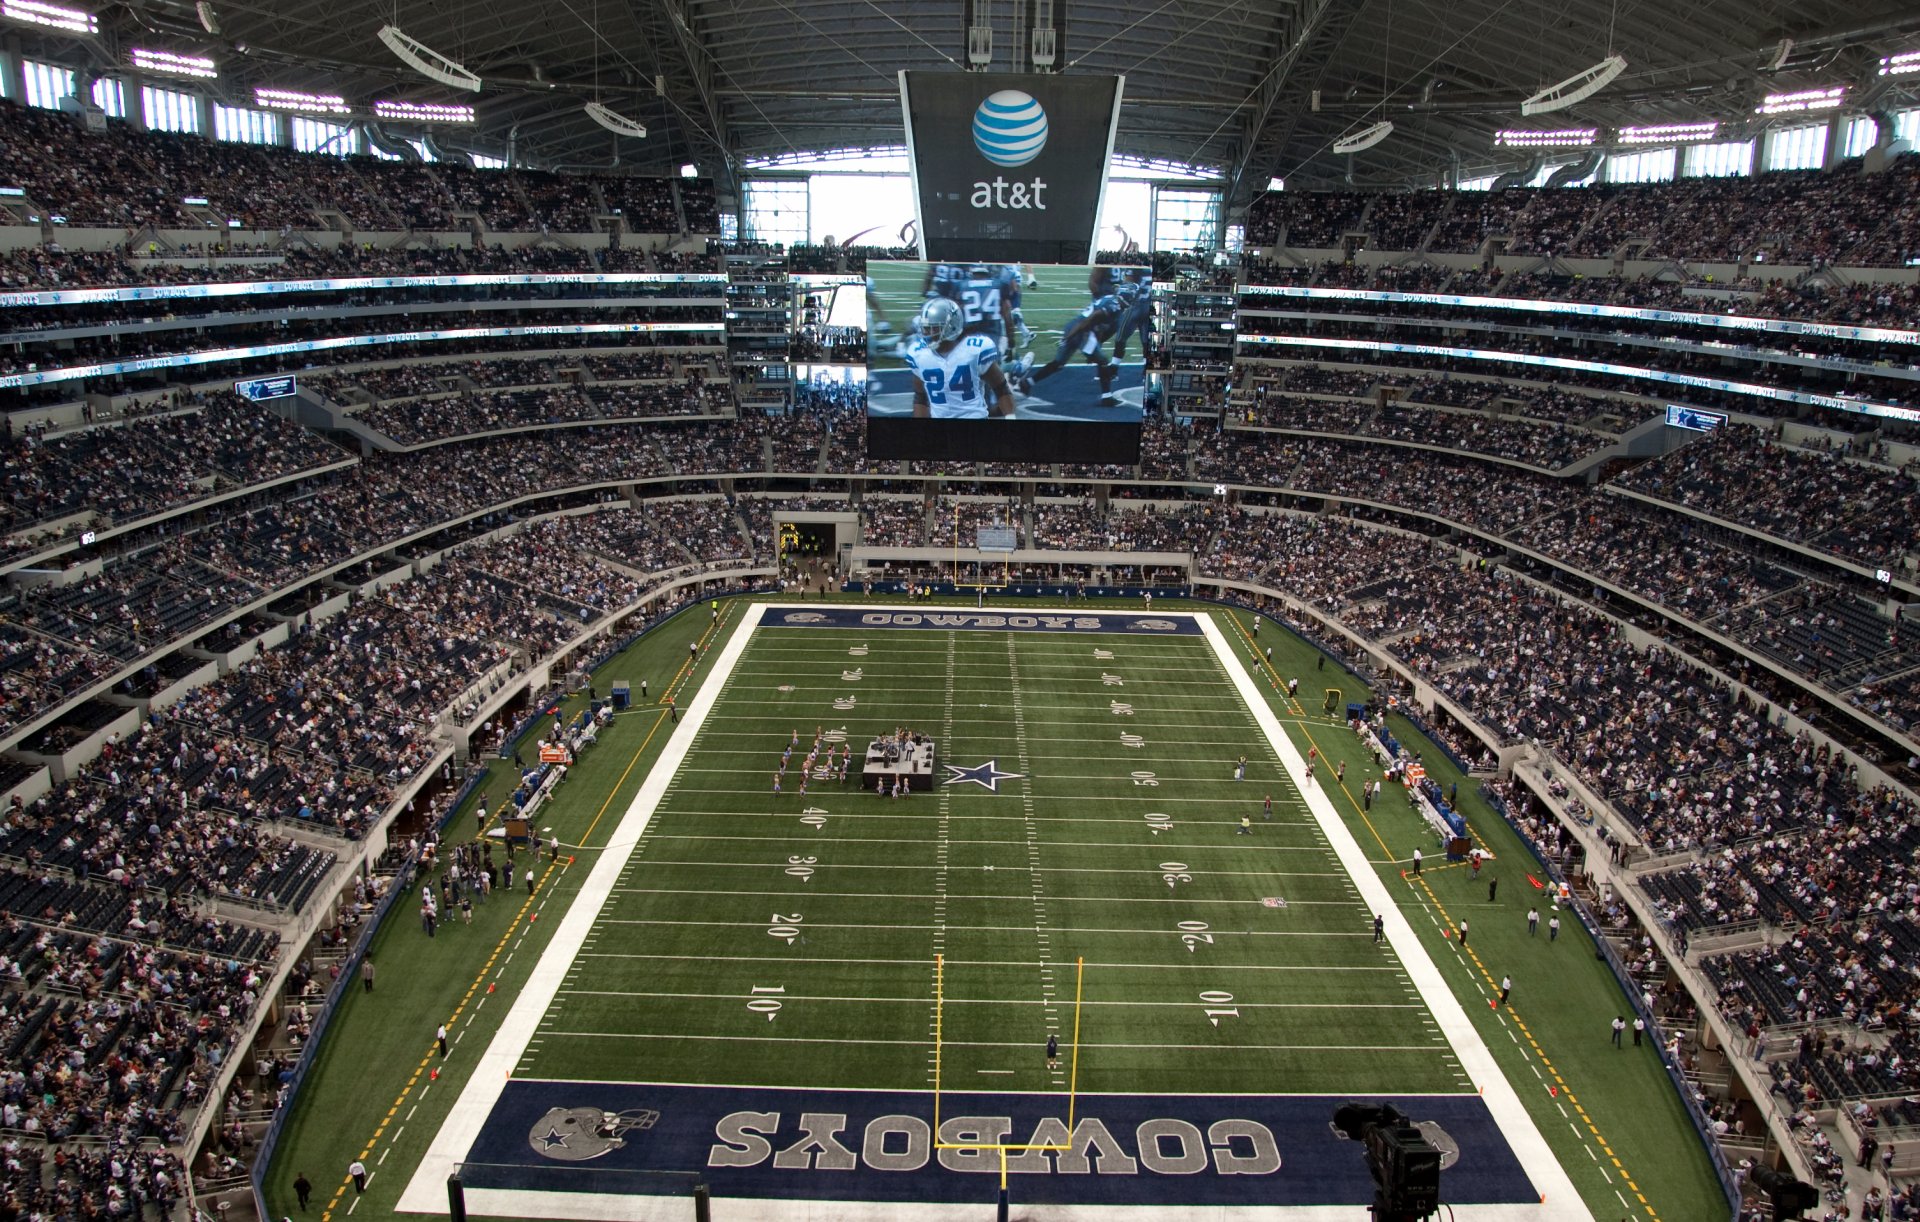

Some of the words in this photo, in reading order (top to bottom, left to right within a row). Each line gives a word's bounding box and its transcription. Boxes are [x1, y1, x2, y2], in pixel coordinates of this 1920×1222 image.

[970, 176, 1047, 210] at&t
[152, 288, 190, 299] COWBOYS
[284, 282, 314, 290] COWBOYS
[404, 277, 438, 285] COWBOYS
[545, 275, 584, 283] COWBOYS
[962, 288, 1001, 323] 24
[1249, 287, 1288, 296] COWBOYS
[1403, 293, 1440, 303] COWBOYS
[1670, 311, 1702, 324] COWBOYS
[1801, 323, 1838, 336] COWBOYS
[1875, 330, 1919, 344] COWBOYS
[62, 366, 102, 380] COWBOYS
[136, 357, 173, 370] COWBOYS
[267, 343, 298, 354] COWBOYS
[386, 332, 420, 342] COWBOYS
[524, 325, 563, 334] COWBOYS
[922, 364, 976, 405] 24
[1415, 344, 1454, 355] COWBOYS
[1679, 375, 1712, 388] COWBOYS
[1809, 394, 1847, 409] COWBOYS
[1883, 406, 1920, 422] COWBOY
[861, 612, 1102, 630] COWBOYS
[832, 697, 857, 710] 30
[1110, 702, 1134, 715] 30
[823, 729, 848, 743] 40
[1120, 735, 1145, 748] 40
[1130, 771, 1160, 786] 50
[799, 806, 829, 825] 40
[1144, 813, 1174, 831] 40
[784, 855, 818, 876] 30
[1159, 862, 1193, 883] 30
[767, 913, 804, 938] 20
[1177, 920, 1214, 945] 20
[746, 984, 786, 1012] 10
[1199, 990, 1240, 1018] 10
[707, 1110, 1282, 1175] COWBOYS
